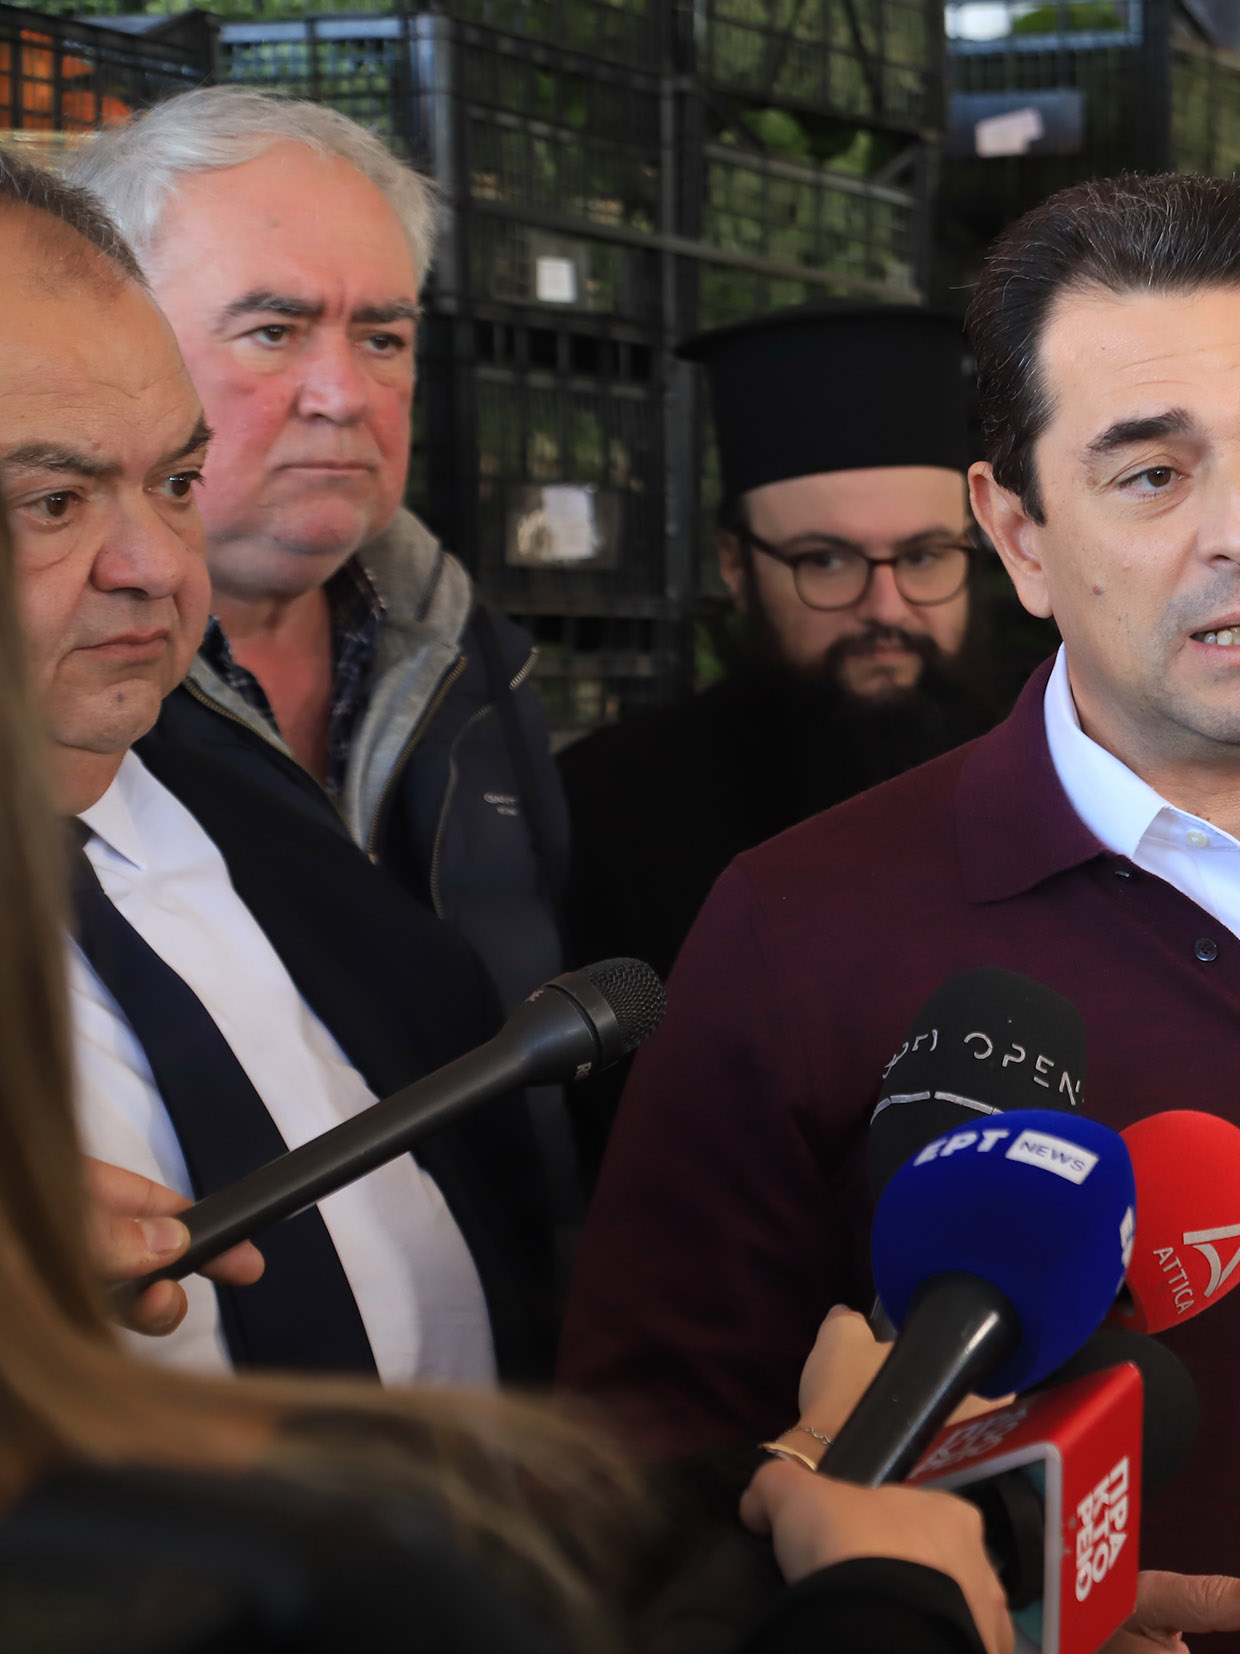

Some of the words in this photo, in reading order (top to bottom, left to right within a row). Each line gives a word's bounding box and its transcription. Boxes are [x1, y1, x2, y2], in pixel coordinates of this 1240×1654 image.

[963, 1032, 1081, 1105] OPEN
[1018, 1141, 1086, 1172] NEWS
[1153, 1247, 1194, 1315] ATTICA
[1093, 1474, 1111, 1583] ΚΤΟ
[1103, 1456, 1129, 1570] ΠΡΑ
